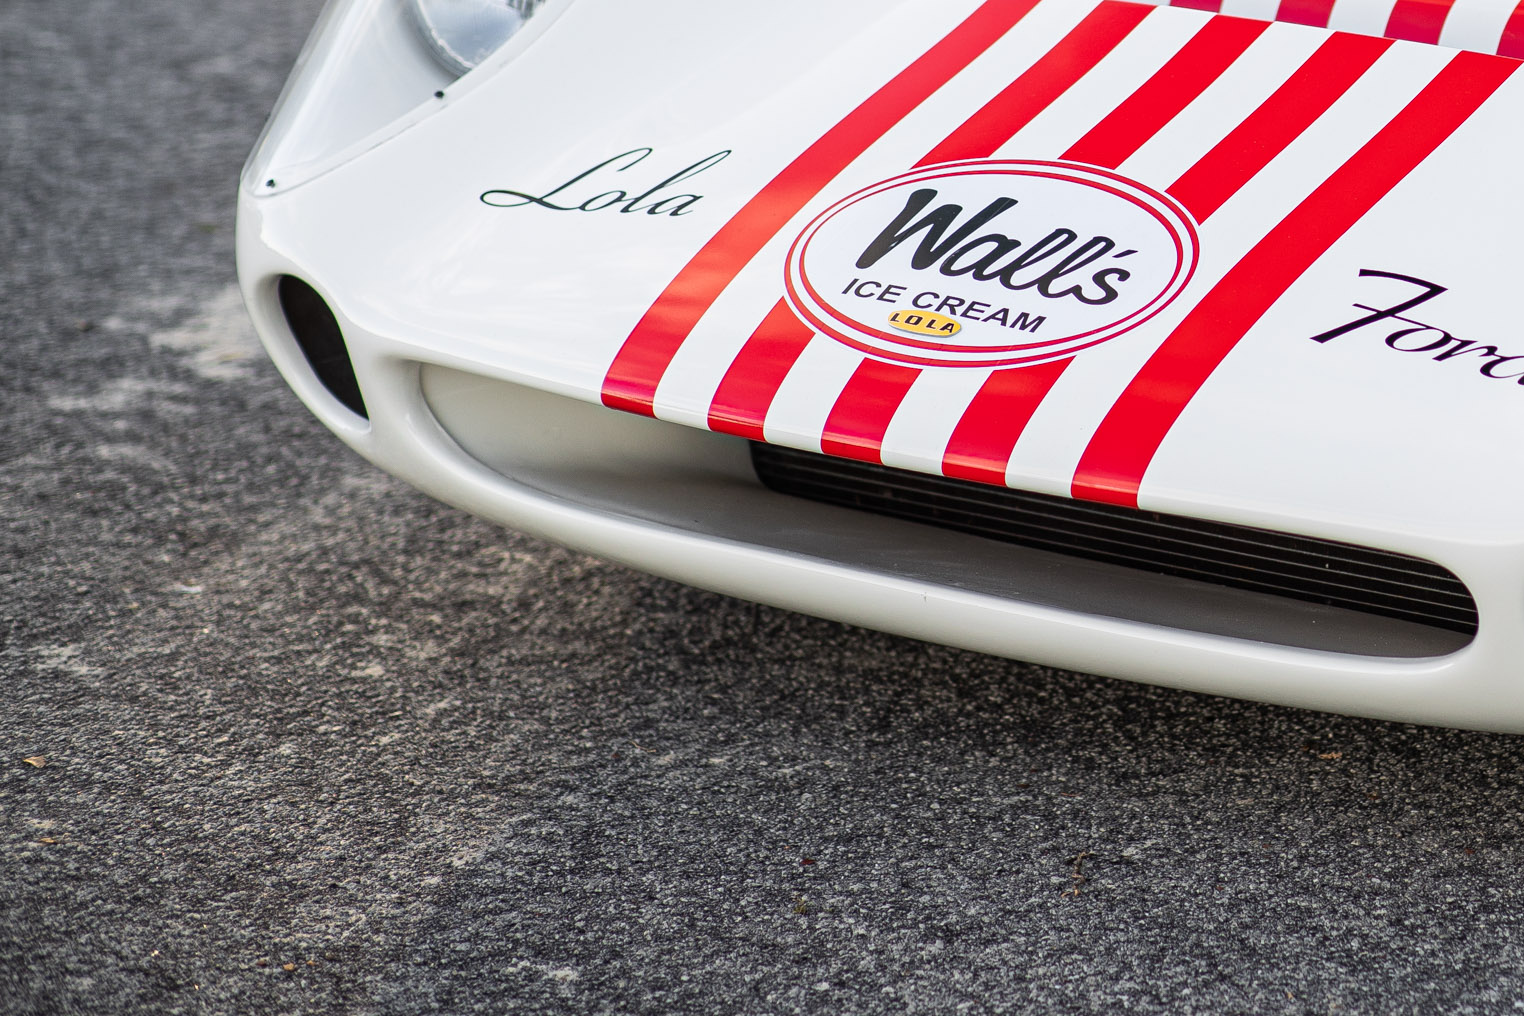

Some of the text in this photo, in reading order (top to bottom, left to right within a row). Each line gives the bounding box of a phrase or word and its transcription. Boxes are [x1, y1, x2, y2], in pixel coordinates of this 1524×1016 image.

[479, 147, 732, 217] Lola
[855, 188, 1139, 306] Wall's
[841, 278, 1048, 334] ICE CREAM
[889, 312, 956, 334] LOLA
